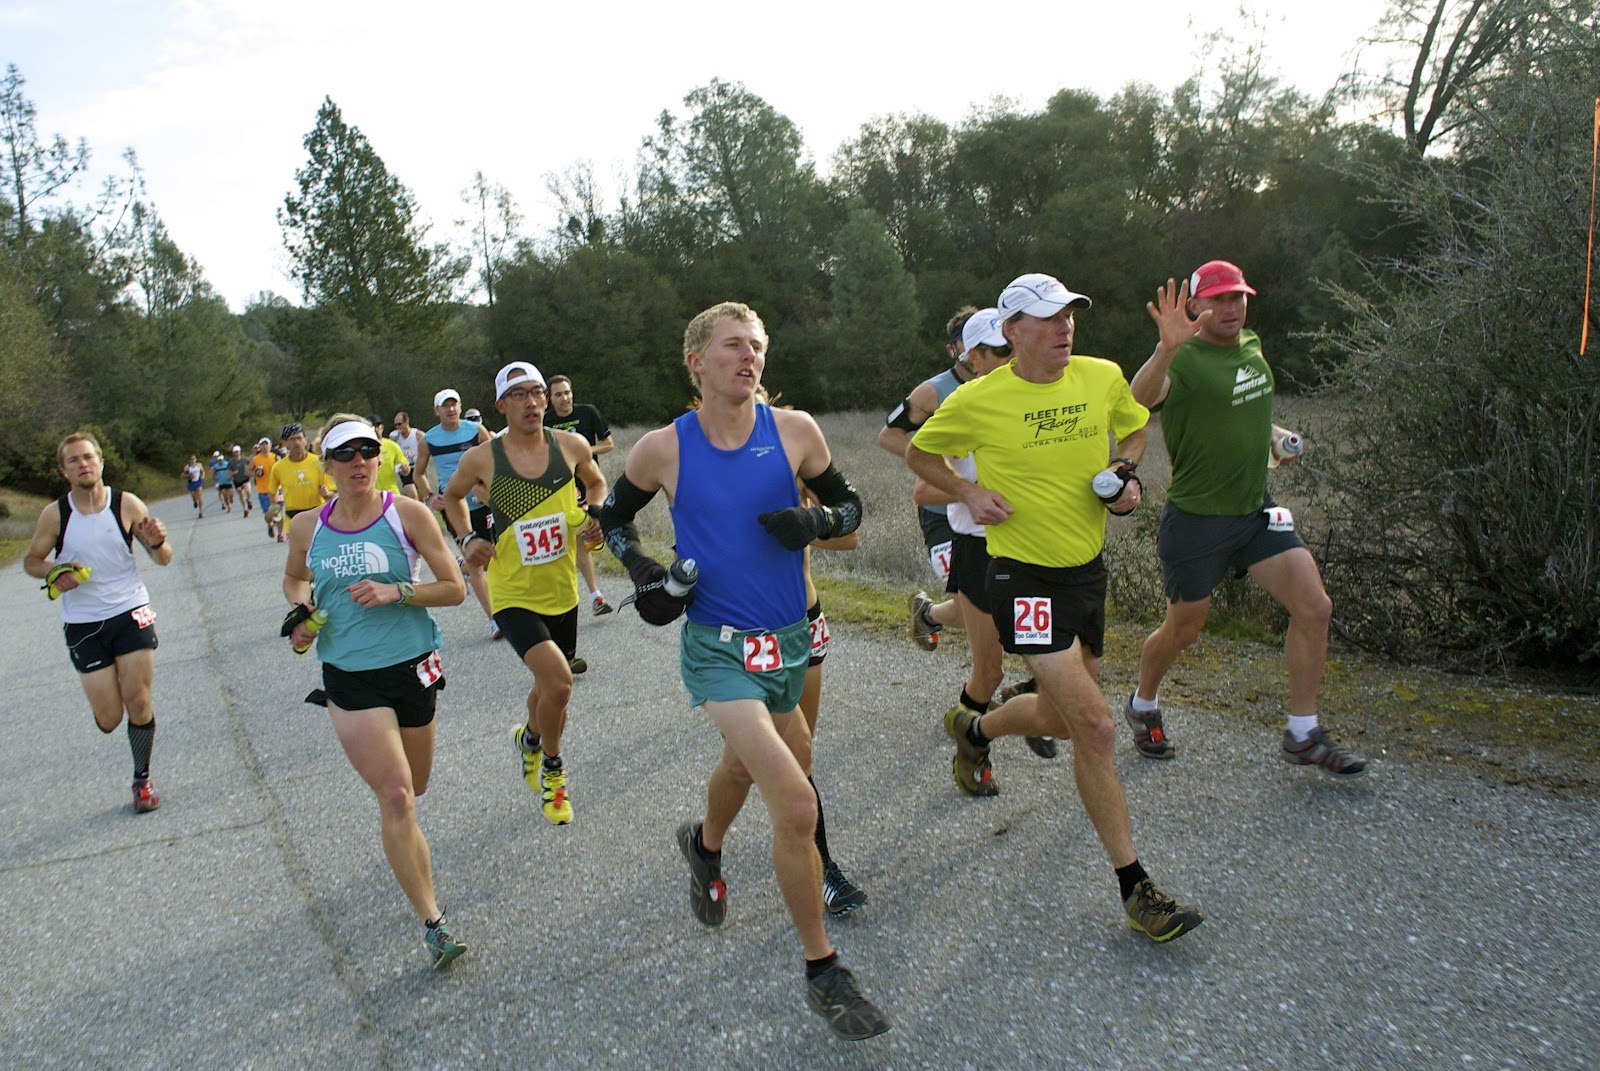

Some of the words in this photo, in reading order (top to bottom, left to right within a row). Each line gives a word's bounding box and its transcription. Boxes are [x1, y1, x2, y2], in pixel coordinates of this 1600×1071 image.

[1024, 408, 1058, 422] FLEET
[1062, 403, 1087, 415] FEET
[1028, 416, 1085, 439] Racing
[1022, 440, 1051, 449] ULTRA
[1053, 436, 1077, 444] TRAIL
[1080, 432, 1098, 440] TEAM
[339, 541, 363, 555] THE
[523, 525, 563, 557] 345
[321, 552, 365, 570] NORTH
[334, 563, 366, 578] FACE
[1015, 600, 1050, 632] 26
[745, 634, 780, 672] 23
